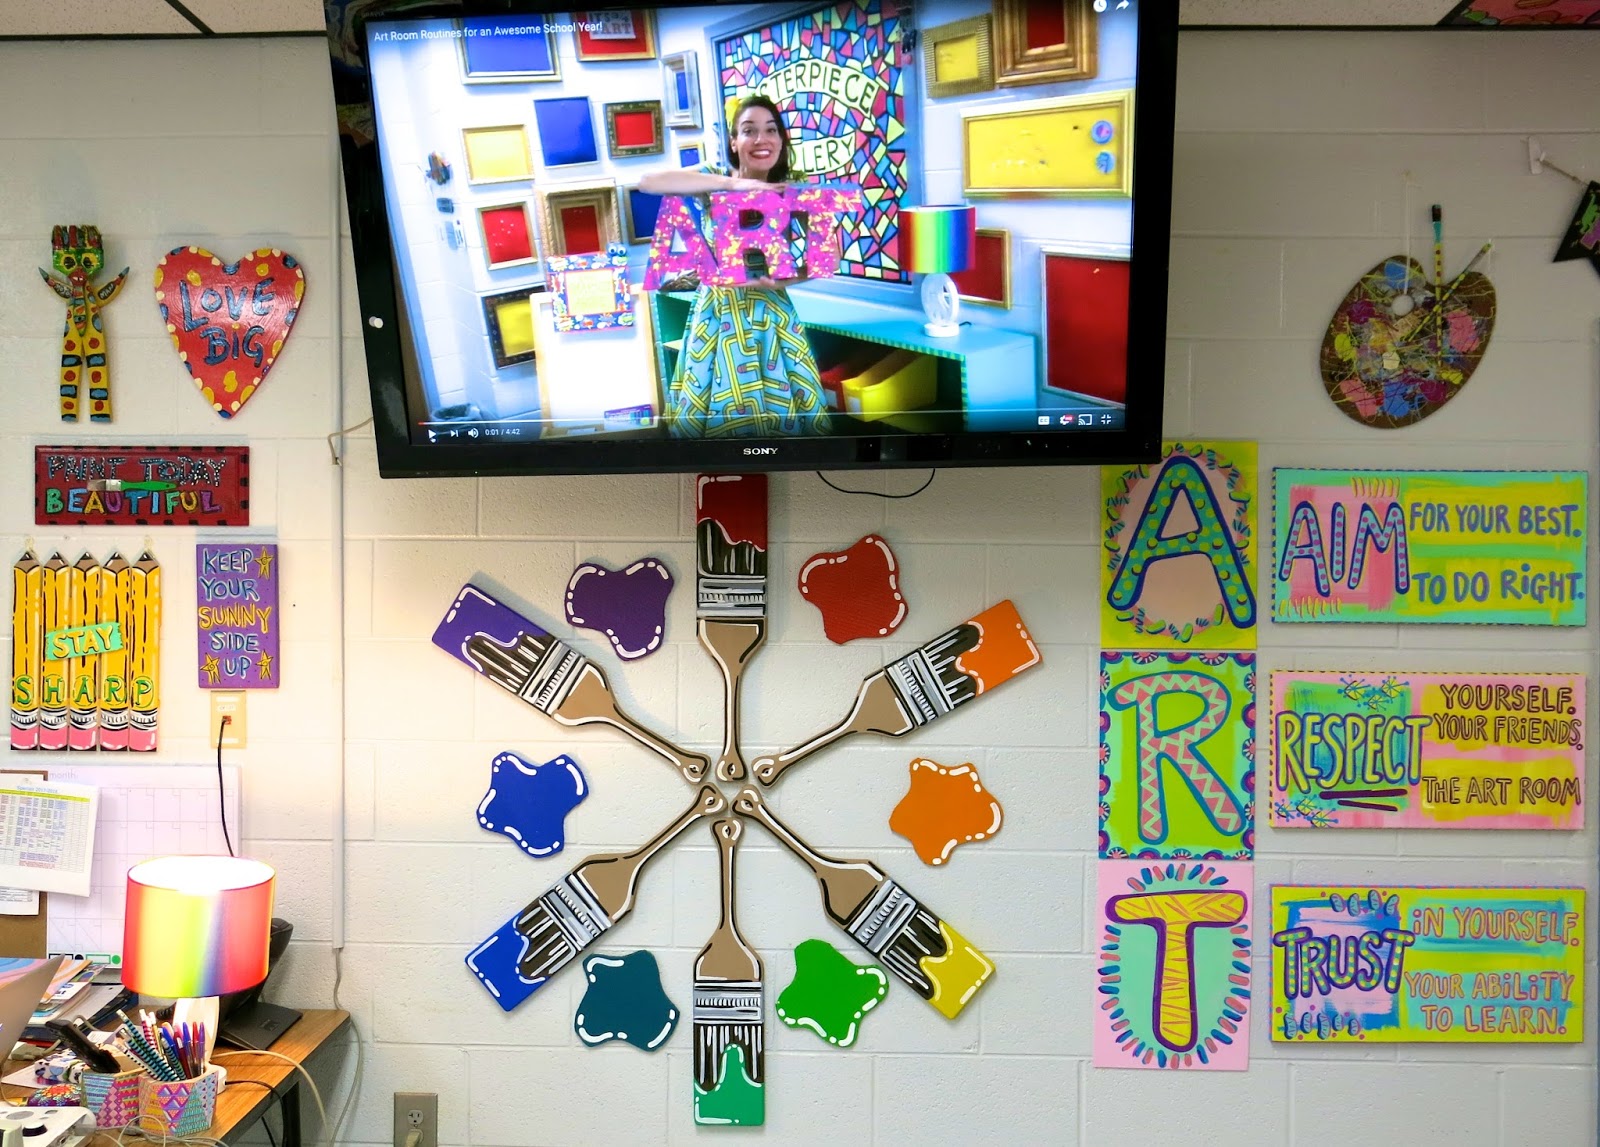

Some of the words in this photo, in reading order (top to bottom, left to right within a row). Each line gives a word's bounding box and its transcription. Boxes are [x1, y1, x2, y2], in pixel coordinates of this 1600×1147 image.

[374, 32, 388, 41] Art
[390, 31, 418, 40] Room
[420, 29, 461, 39] Routines
[464, 27, 477, 37] for
[480, 28, 492, 37] an
[494, 25, 541, 36] Awesome
[543, 22, 576, 33] School
[578, 21, 603, 31] Year!
[759, 62, 875, 113] STERPIECE
[803, 136, 854, 173] LERY
[642, 187, 862, 291] ART
[179, 277, 275, 332] LOVE
[743, 447, 778, 455] SONY
[47, 455, 127, 481] PAINT
[138, 455, 227, 486] TODAY
[46, 488, 222, 515] BEAUTIFUL
[1409, 502, 1449, 532] FOR
[1455, 504, 1511, 534] YOUR
[1518, 504, 1582, 538] BEST.
[1107, 456, 1257, 627] A
[1278, 501, 1410, 597] AIM
[203, 548, 253, 575] KEEP
[199, 577, 260, 601] YOUR
[1412, 572, 1447, 604] TO
[1453, 571, 1489, 602] DO
[199, 603, 272, 634] SUNNY
[52, 625, 113, 658] STAY
[209, 631, 260, 653] SIDE
[224, 655, 251, 679] UP
[15, 676, 153, 705] SHARP
[1440, 684, 1576, 715] YOURSELF.
[1434, 714, 1488, 742] YOUR
[1108, 670, 1247, 845] R
[1276, 710, 1433, 794] RESPECT
[1422, 777, 1461, 803] THE
[1466, 777, 1512, 806] ART
[1519, 777, 1581, 806] ROOM
[1453, 907, 1579, 947] YOURSELF.
[1105, 889, 1247, 1052] T
[1273, 926, 1415, 999] TRUST
[1404, 971, 1465, 1000] YOUR
[1420, 1004, 1453, 1031] TO
[1464, 1005, 1567, 1035] LEARN.
